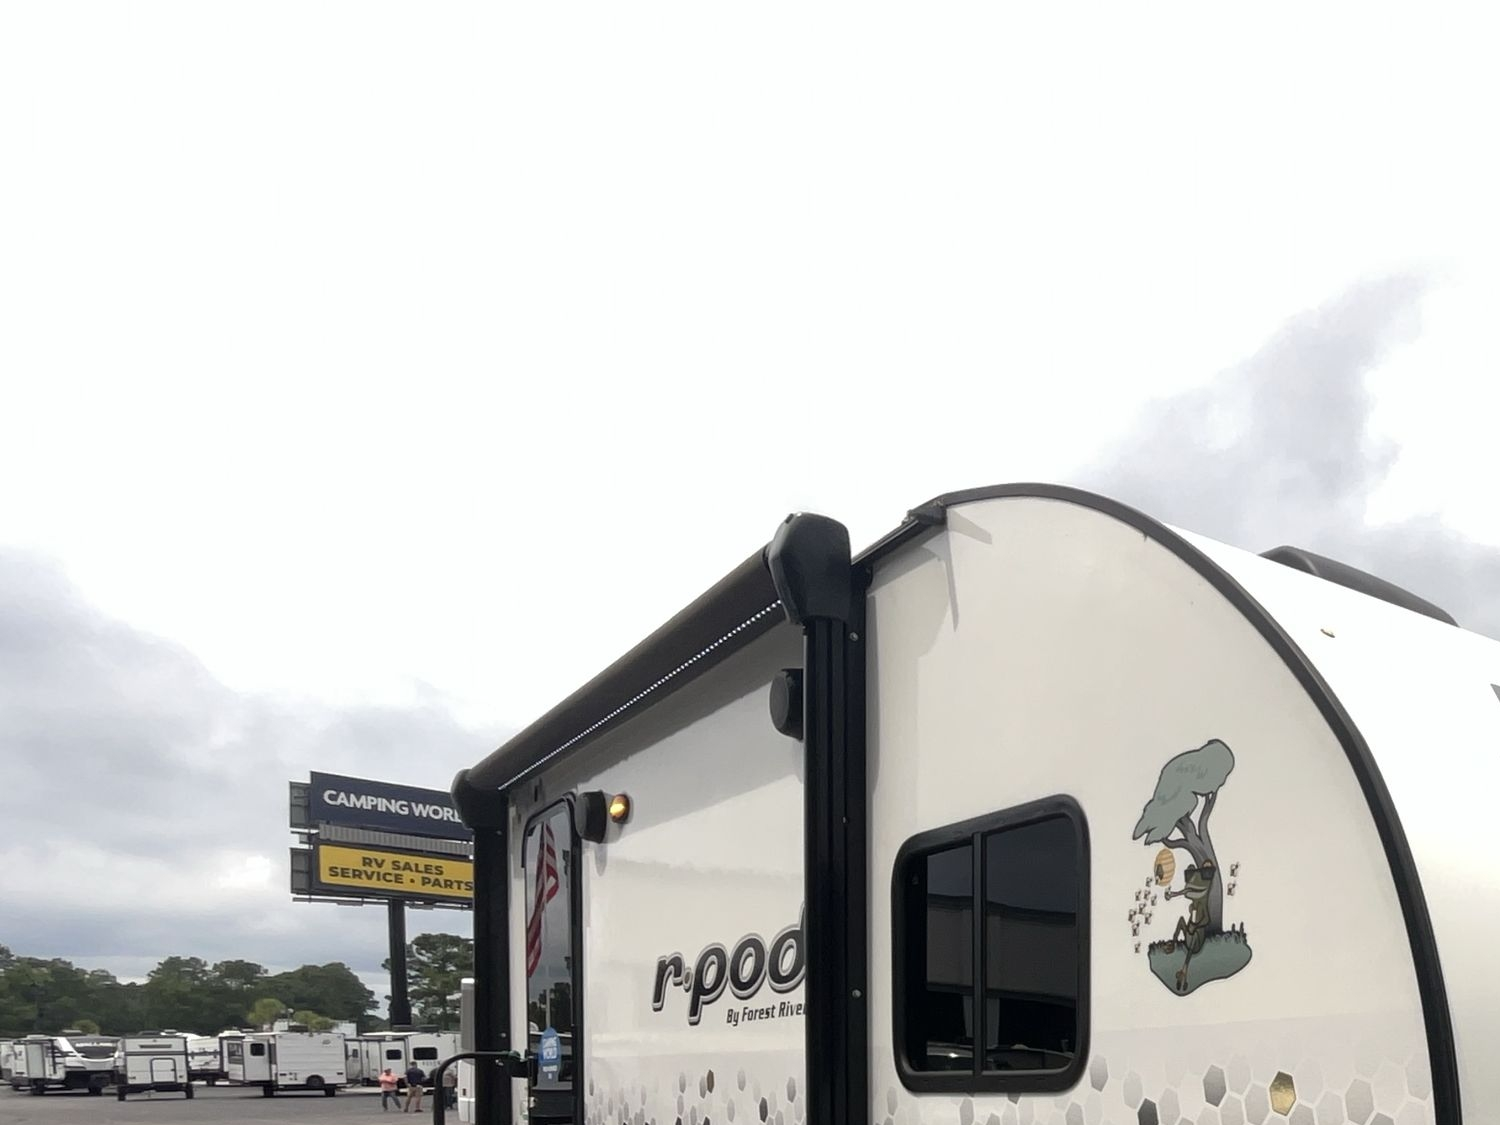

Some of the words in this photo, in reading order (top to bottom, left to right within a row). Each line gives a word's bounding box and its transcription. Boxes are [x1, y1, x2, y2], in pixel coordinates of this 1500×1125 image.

[323, 789, 409, 815] CAMPING
[362, 856, 386, 868] RV
[392, 860, 444, 875] SALES
[328, 866, 404, 884] SERVICE
[421, 876, 473, 891] PARTS
[726, 1008, 740, 1026] By
[741, 1004, 776, 1022] Forest
